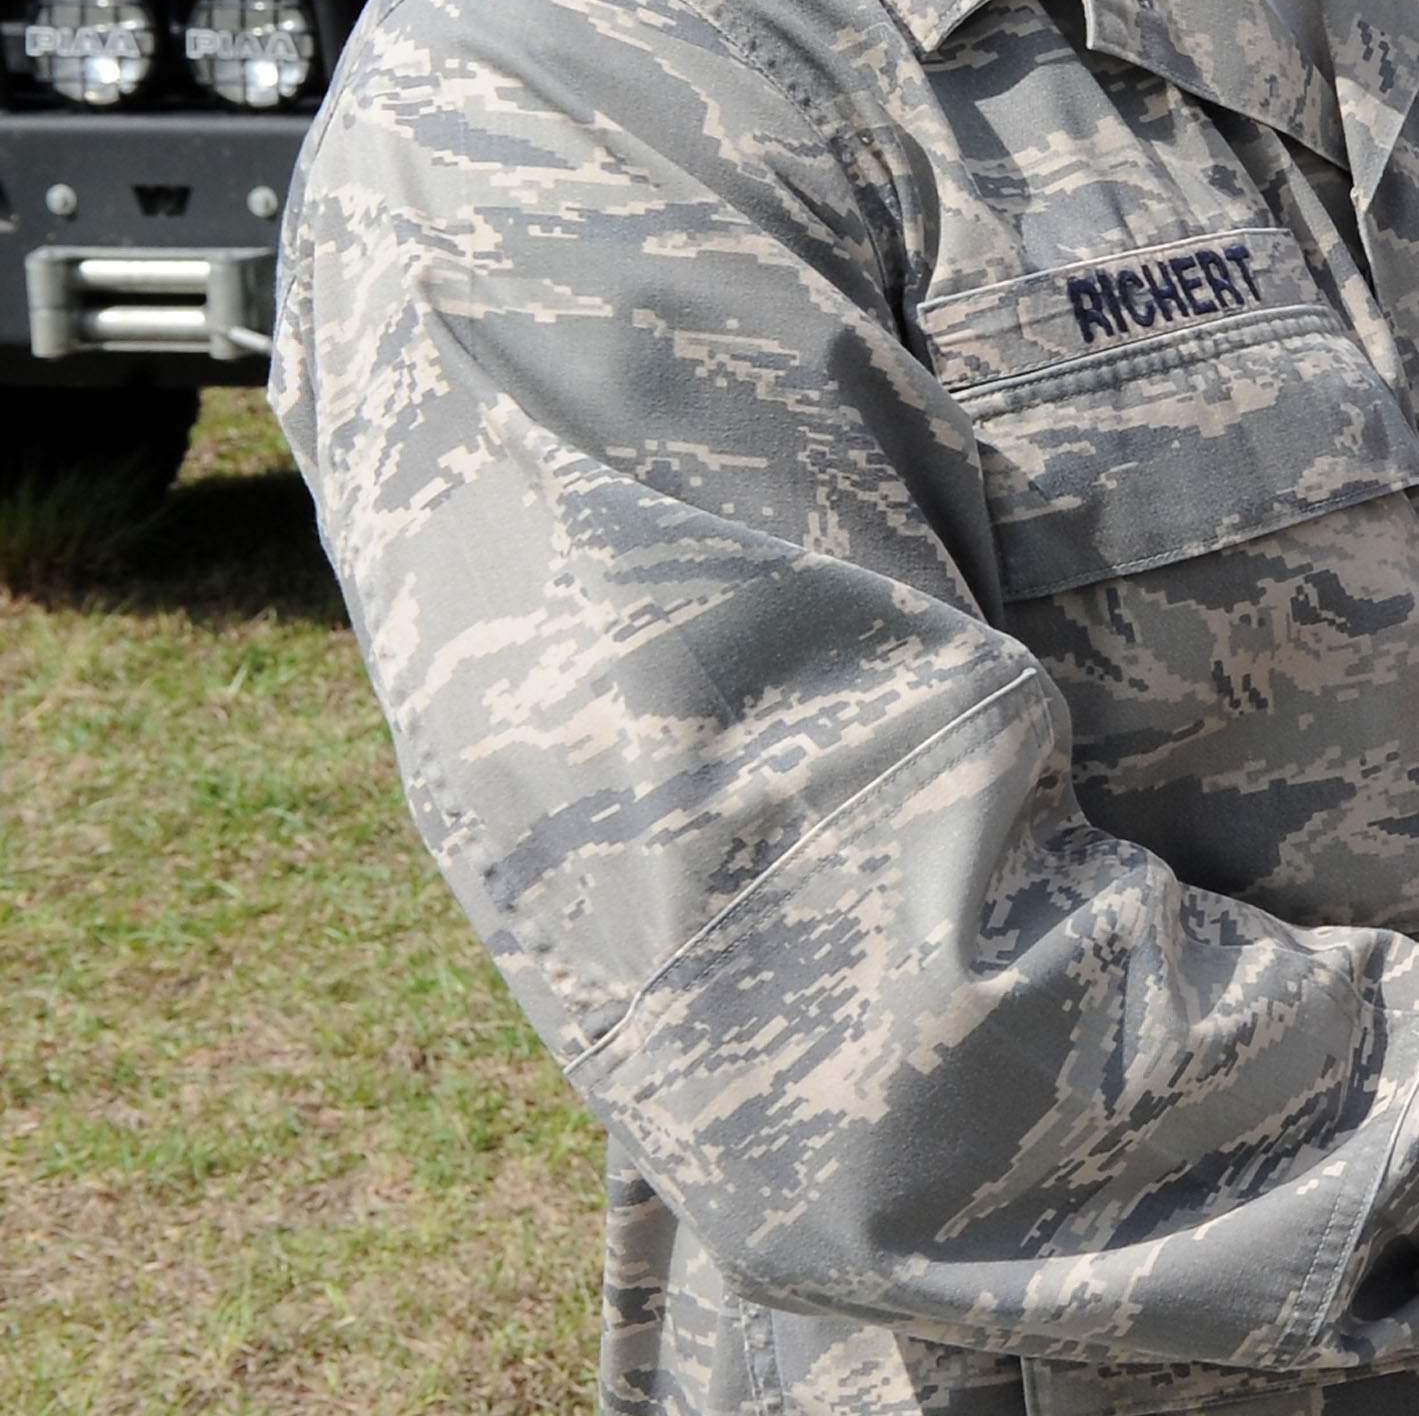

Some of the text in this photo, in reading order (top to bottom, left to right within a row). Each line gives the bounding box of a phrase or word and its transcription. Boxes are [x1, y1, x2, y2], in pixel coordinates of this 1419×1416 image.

[25, 25, 141, 58] PIAA
[185, 27, 300, 62] PIAA
[1066, 244, 1262, 343] RICHERT
